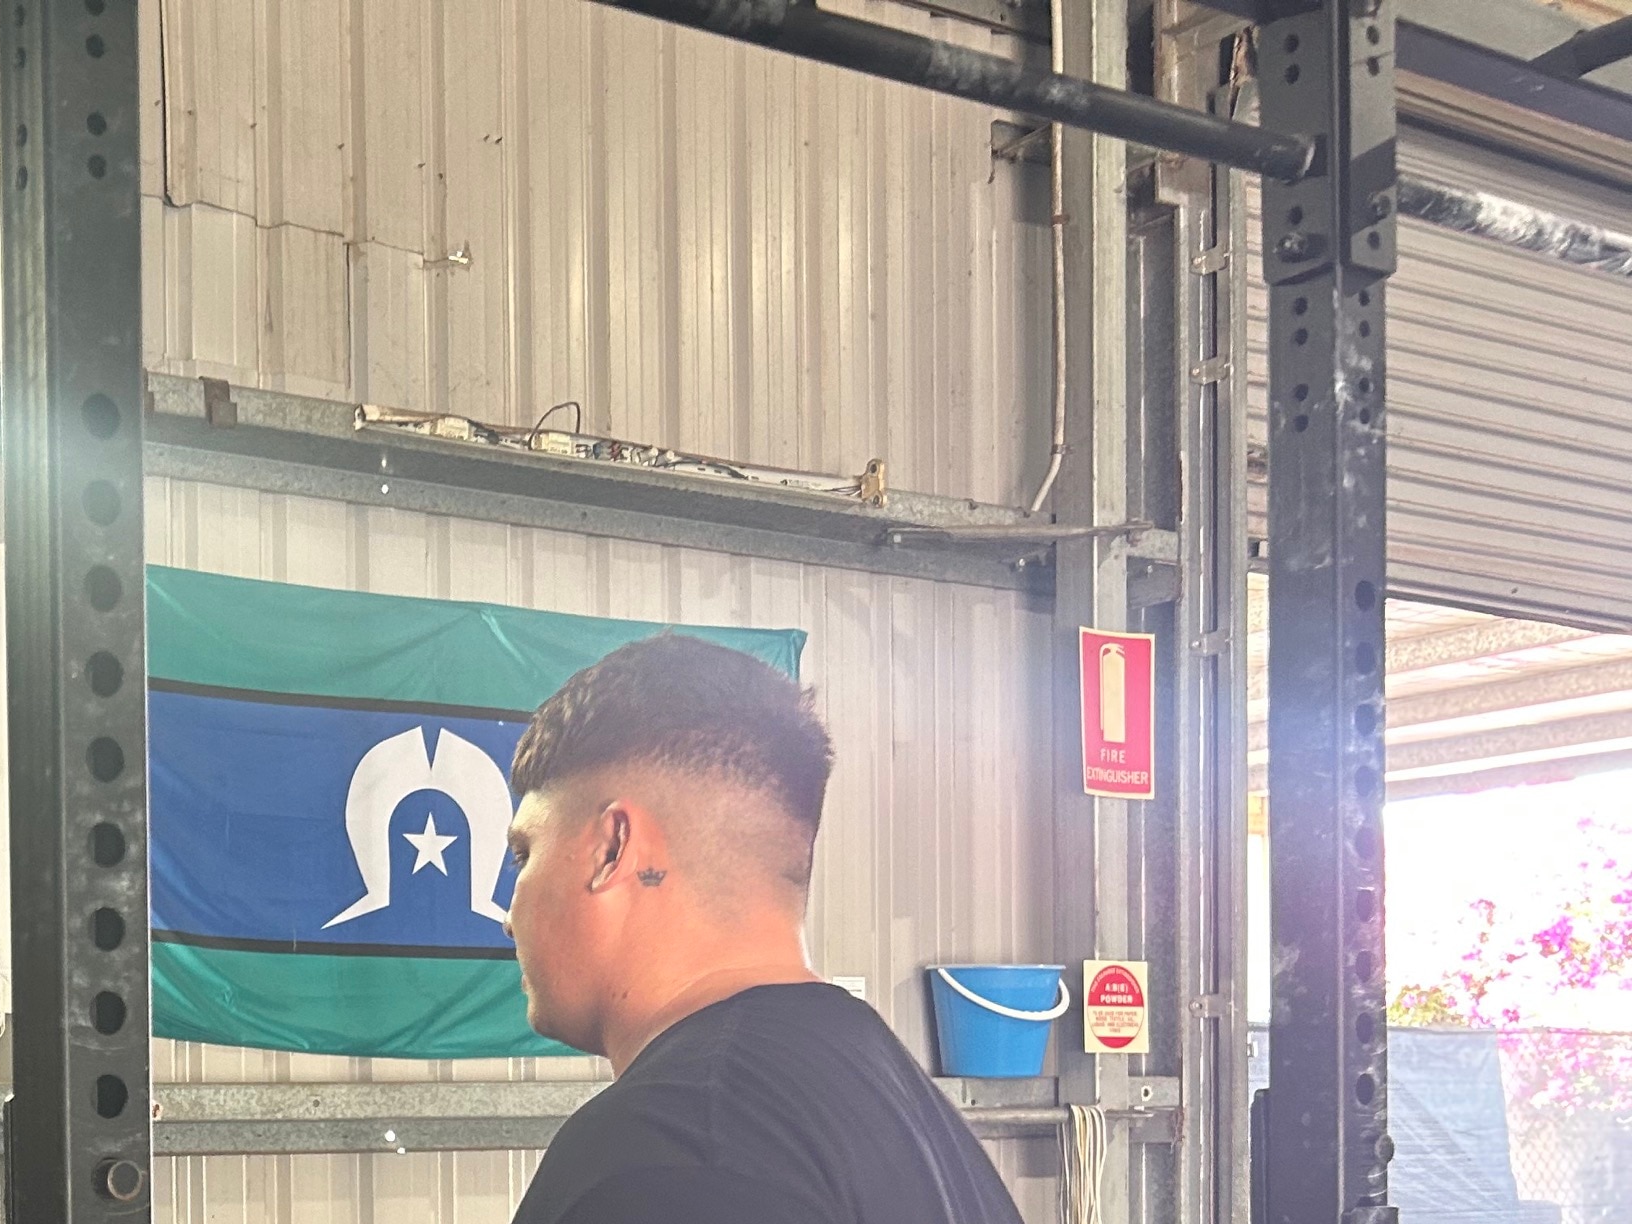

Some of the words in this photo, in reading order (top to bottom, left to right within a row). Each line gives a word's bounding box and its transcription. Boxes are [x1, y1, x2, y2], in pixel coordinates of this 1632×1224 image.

[1100, 748, 1126, 764] FIRE
[1086, 766, 1149, 785] EXTINGUISHER
[1100, 994, 1134, 1005] POWDER
